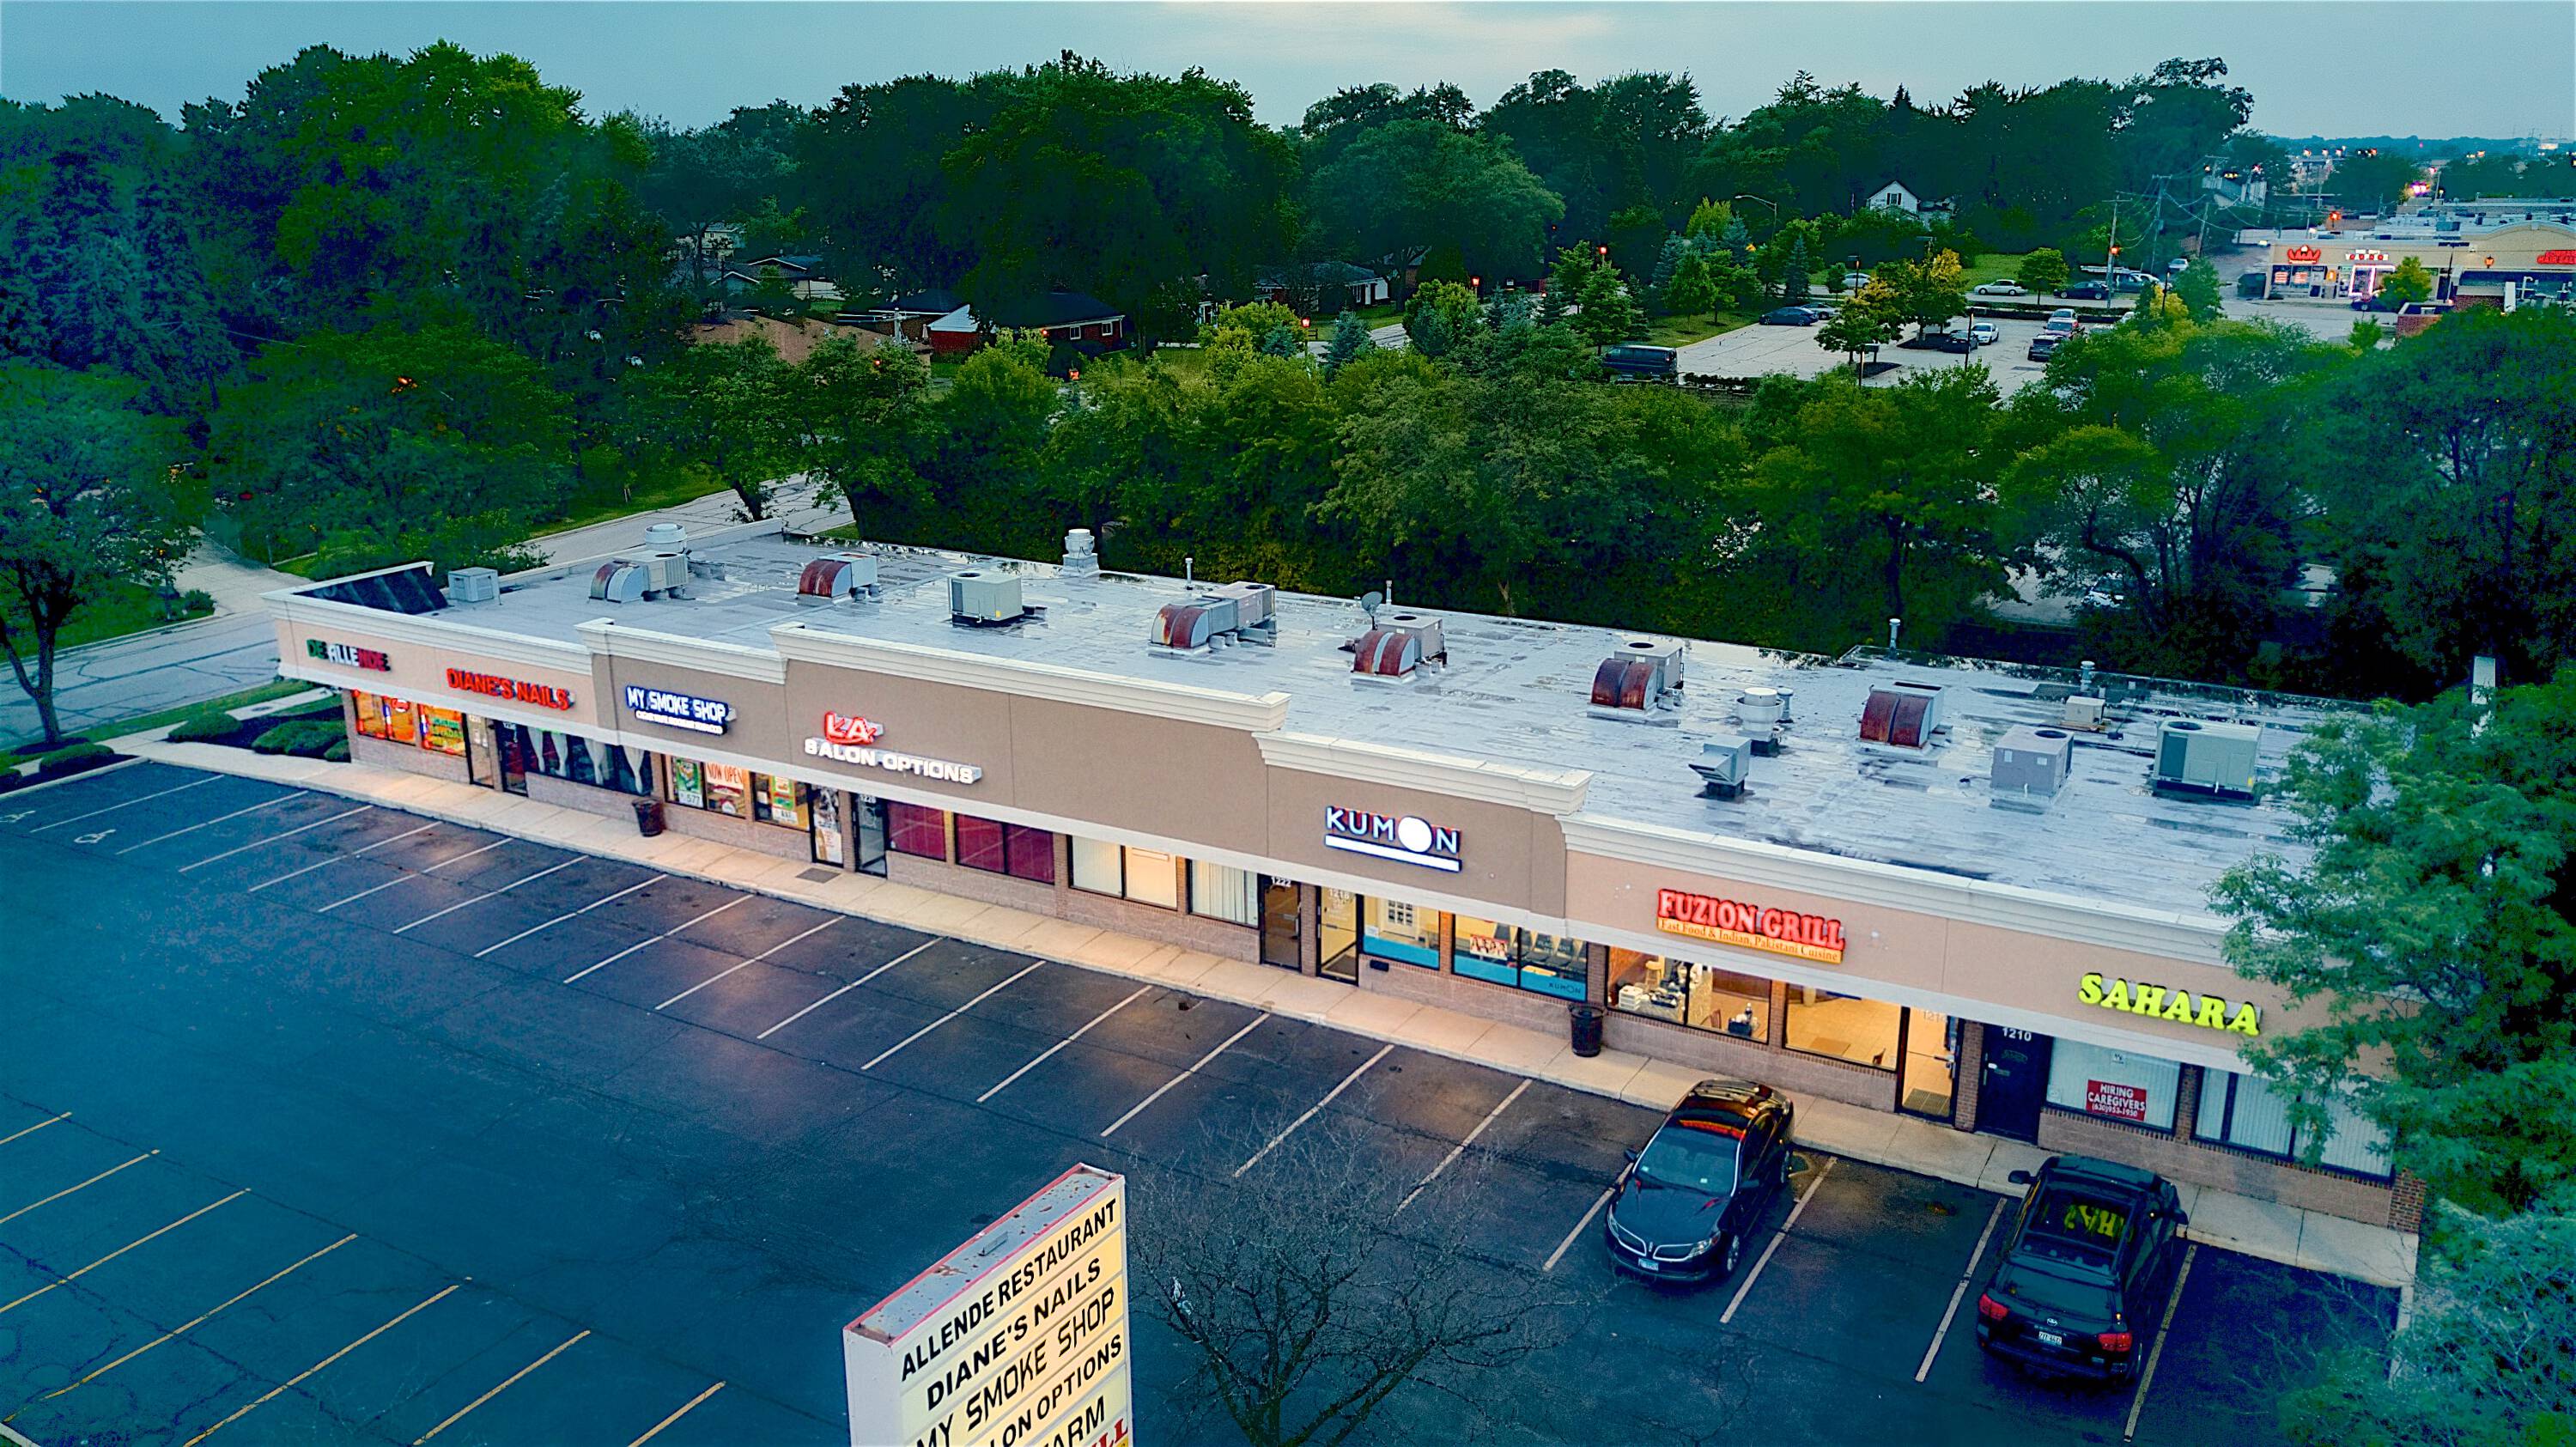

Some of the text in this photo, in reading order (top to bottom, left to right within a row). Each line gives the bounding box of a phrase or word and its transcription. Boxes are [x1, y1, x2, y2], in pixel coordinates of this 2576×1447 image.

[307, 639, 387, 672] DE ALLENDE
[446, 667, 571, 710] DIANE'S NAILS
[626, 686, 645, 708] MY
[647, 690, 690, 715] SMOKE
[692, 699, 726, 723] SHOP
[707, 762, 743, 784] NOW OPEN
[804, 738, 975, 785] SALON OPTIONS
[1325, 805, 1461, 854] KUMON
[1271, 876, 1291, 888] 1222
[1657, 888, 1846, 951] FUZION GRILL
[1682, 922, 1707, 937] Food
[1754, 937, 1798, 954] Pakistani
[1801, 945, 1838, 962] Cuisine
[1548, 981, 1582, 994] KUMON
[2077, 971, 2261, 1037] SAHARA
[2002, 1027, 2032, 1043] 1210
[2087, 1091, 2146, 1112] CAREGIVERS
[2099, 1084, 2135, 1099] HIRING
[901, 1198, 1117, 1383] ALLENDE RESTAURANT
[927, 1256, 1102, 1412] DIANE'S NAILS
[967, 1340, 1048, 1432] SMOKE
[1058, 1286, 1115, 1358] SHOP
[1036, 1333, 1121, 1421] OPTIONS
